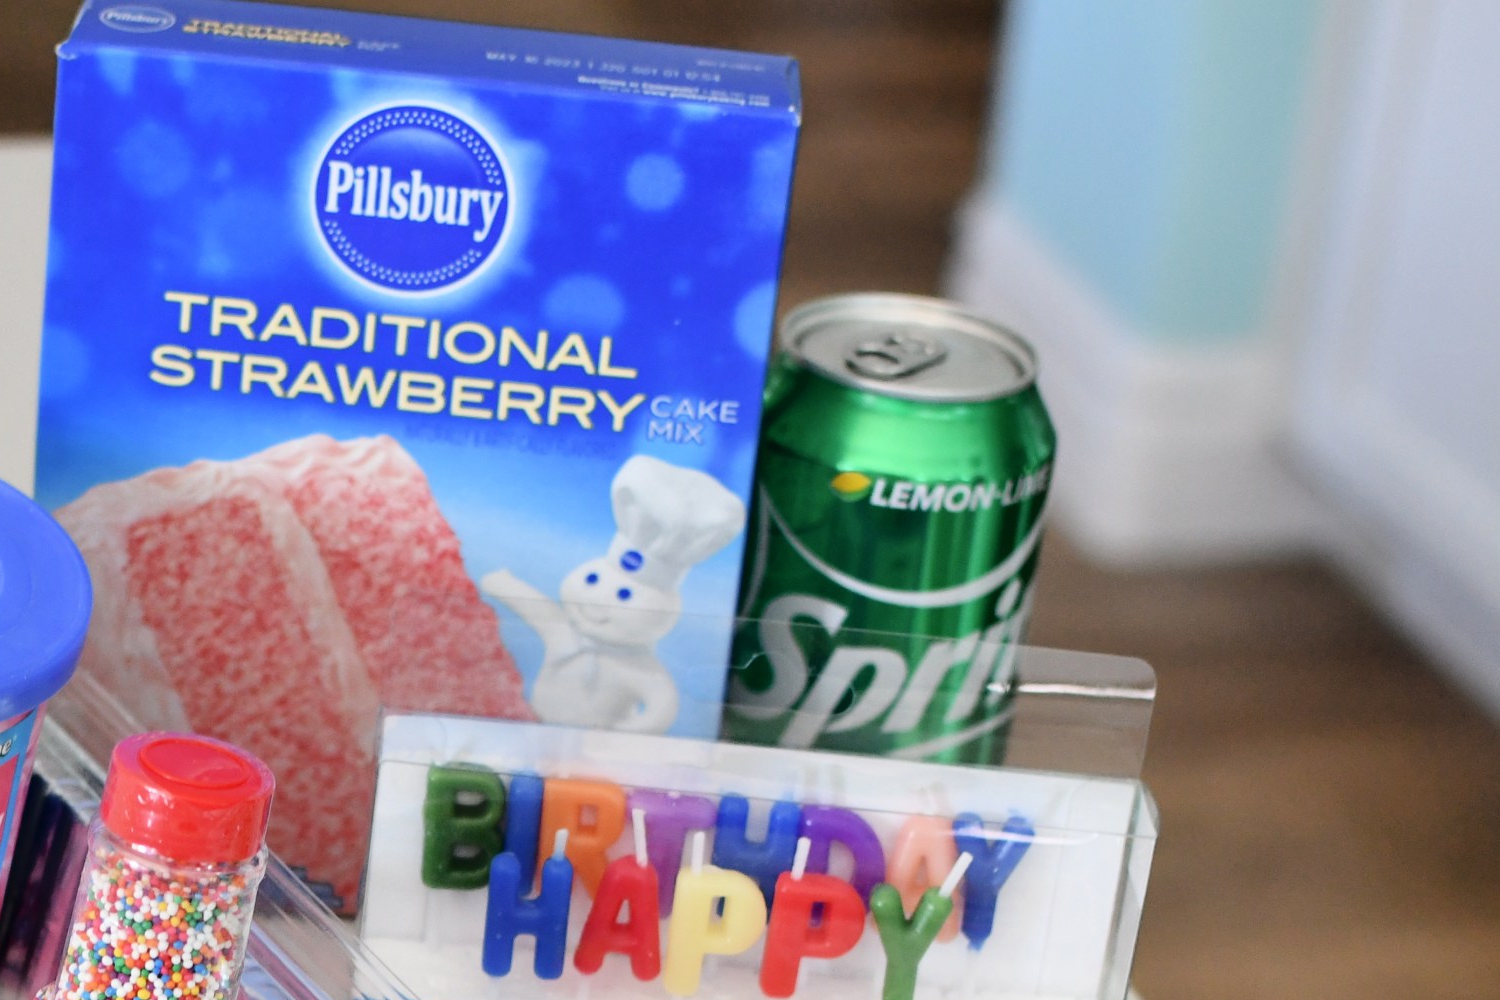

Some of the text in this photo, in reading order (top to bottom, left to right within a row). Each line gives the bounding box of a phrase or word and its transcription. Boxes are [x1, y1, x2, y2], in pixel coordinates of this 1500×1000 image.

[324, 160, 504, 242] Pillsbury
[164, 290, 638, 380] TRADITIONAL
[150, 343, 647, 433] STRAWBERRY
[649, 395, 740, 425] CAKE
[648, 420, 705, 446] MIX
[422, 763, 1037, 950] BIRTHDAY
